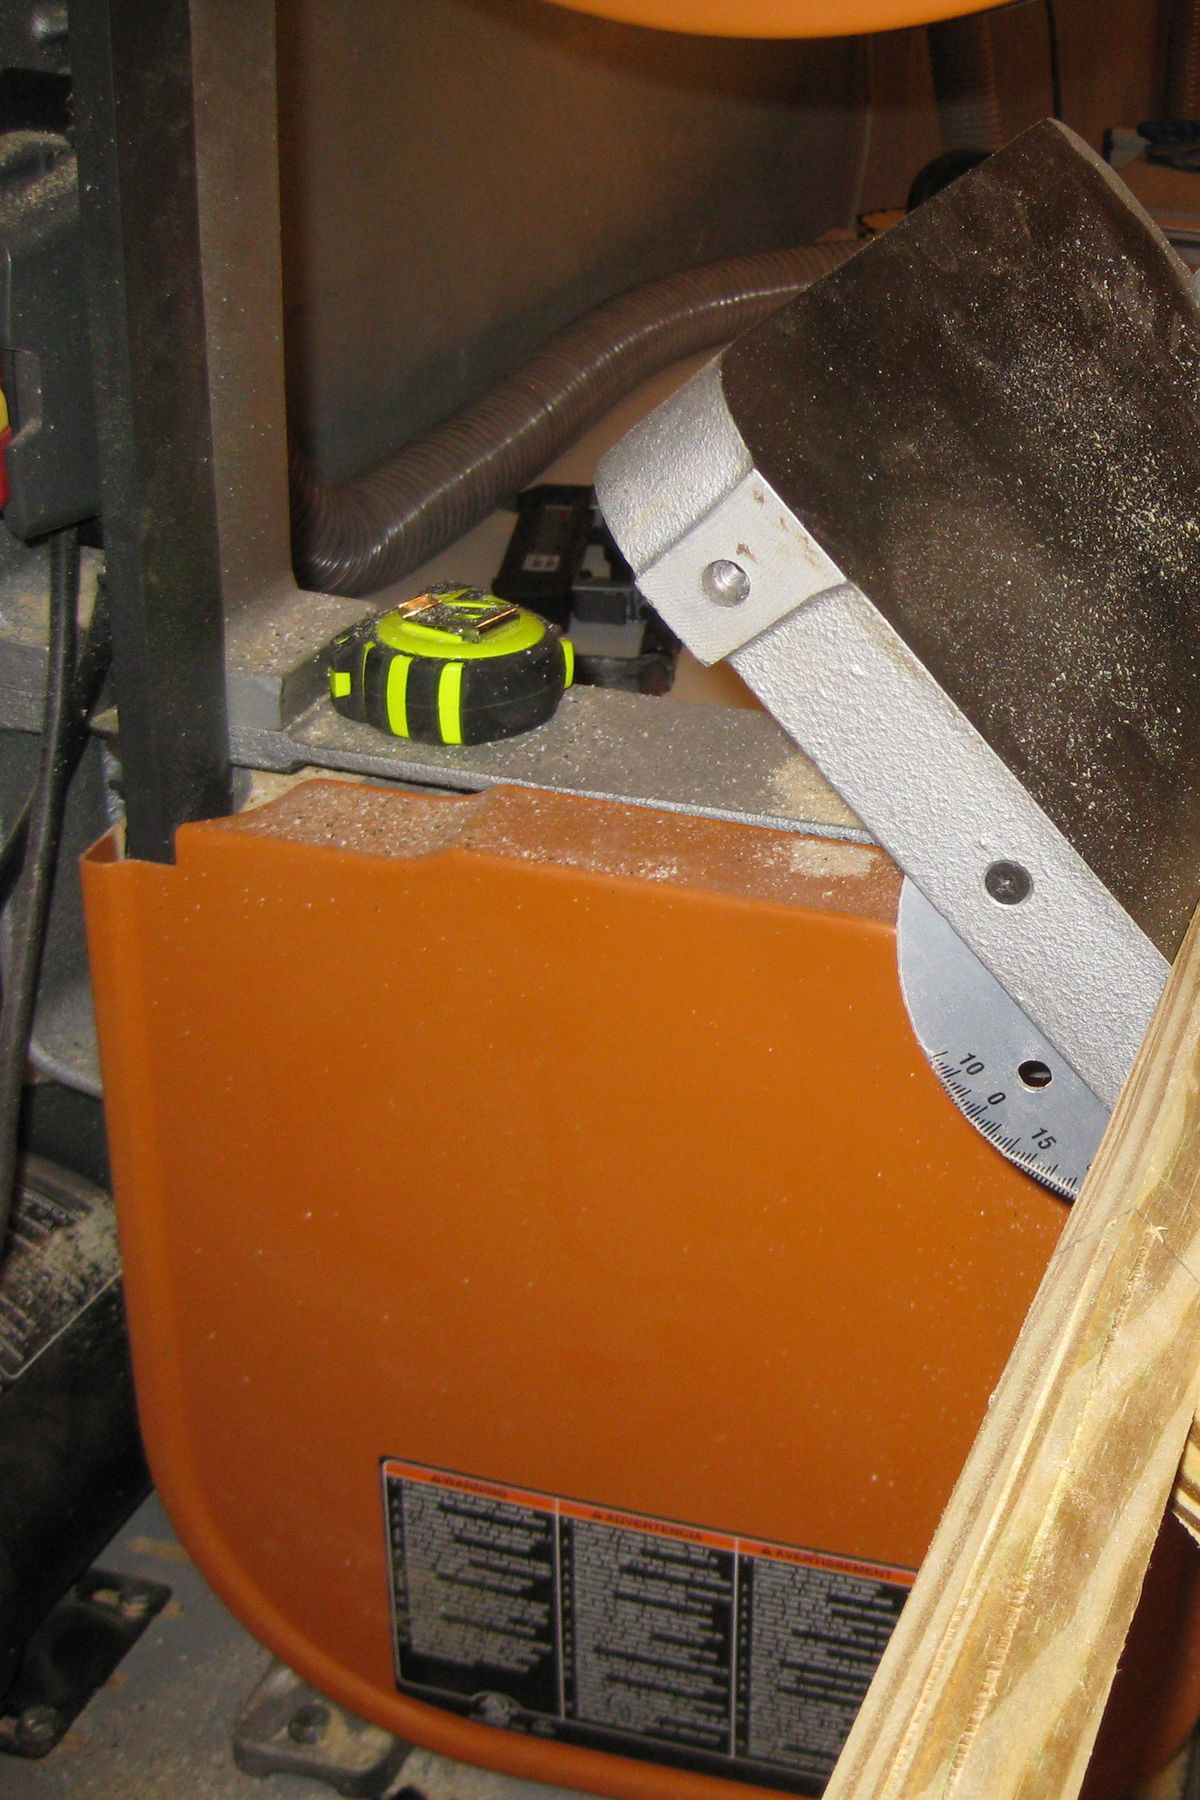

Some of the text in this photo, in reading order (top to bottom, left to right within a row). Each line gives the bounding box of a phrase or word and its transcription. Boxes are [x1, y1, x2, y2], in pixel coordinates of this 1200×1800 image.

[959, 1052, 985, 1076] 10
[987, 1091, 1006, 1105] 0
[1031, 1127, 1057, 1150] 15
